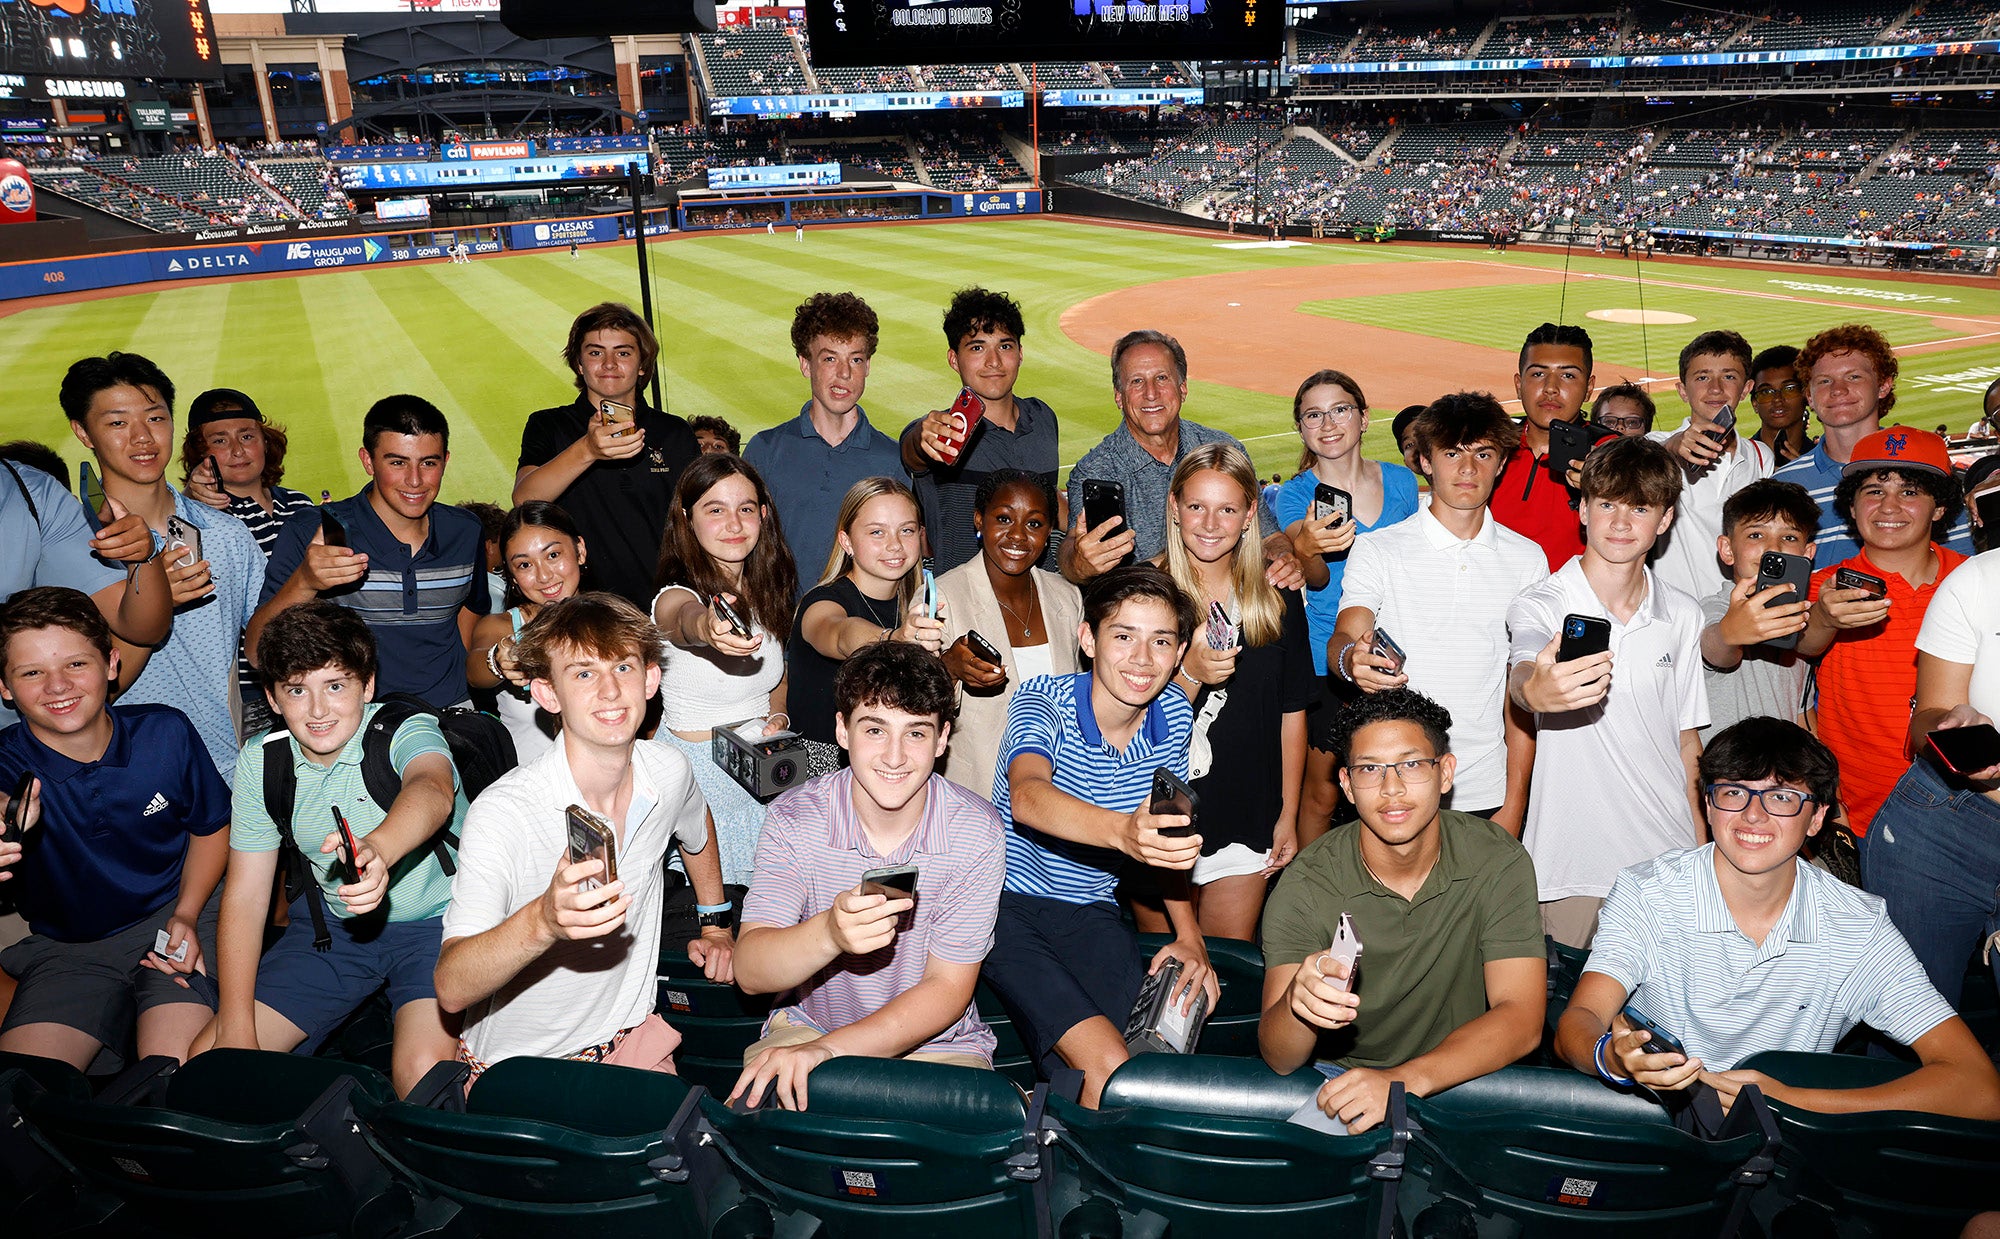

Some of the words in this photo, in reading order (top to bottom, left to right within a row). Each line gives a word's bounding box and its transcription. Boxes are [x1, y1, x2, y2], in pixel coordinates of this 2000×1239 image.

[893, 8, 946, 26] COLORADO
[948, 7, 992, 24] ROCKIES
[1101, 6, 1125, 22] NEW
[1127, 6, 1157, 22] YORK
[1158, 5, 1189, 21] METS
[44, 79, 126, 98] SAMSUNG
[447, 145, 468, 158] citi
[473, 146, 526, 157] PAVILION
[979, 201, 1011, 213] Corona
[270, 224, 286, 233] LIGHT
[329, 219, 348, 228] LIGHT
[550, 220, 595, 232] CAESARS
[658, 224, 669, 233] 370
[220, 229, 238, 237] LIGHT
[552, 231, 588, 239] SPORTSBOOK
[286, 242, 312, 260] HG
[312, 246, 362, 257] HAUGLAND
[416, 248, 440, 256] GOYA
[475, 242, 498, 251] GOYA
[392, 250, 409, 260] 380
[188, 254, 249, 269] DELTA
[314, 257, 345, 267] GROUP
[43, 271, 65, 283] 408
[142, 800, 169, 817] adidas
